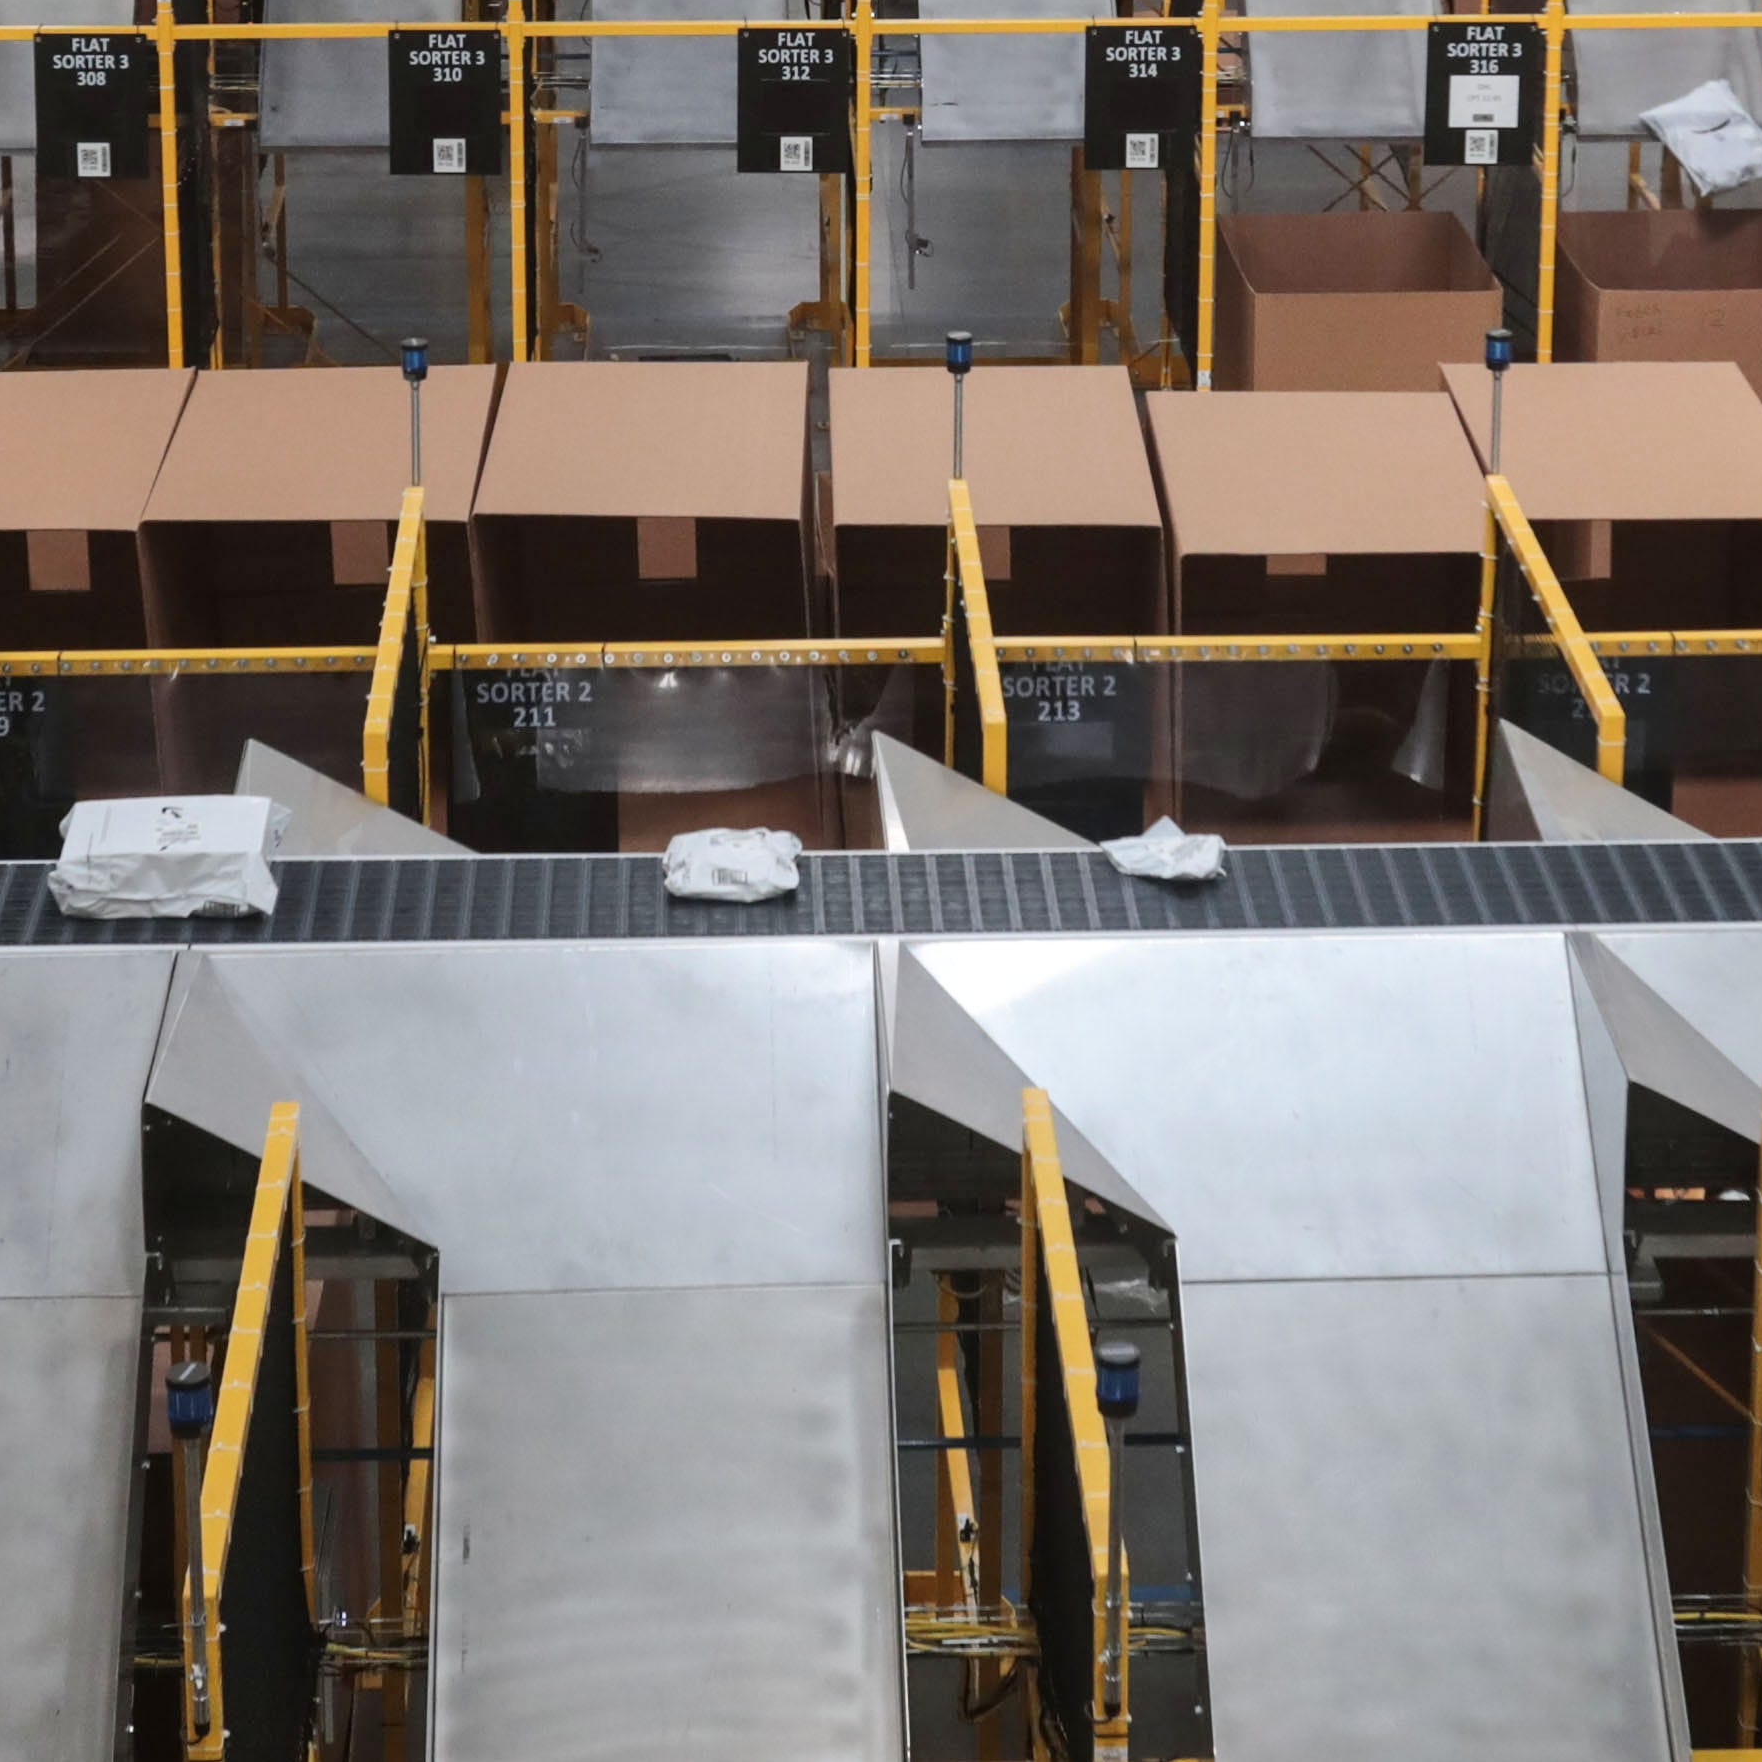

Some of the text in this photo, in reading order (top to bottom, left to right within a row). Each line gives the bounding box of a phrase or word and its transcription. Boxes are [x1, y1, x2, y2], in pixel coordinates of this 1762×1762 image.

[428, 33, 467, 49] FLAT
[777, 32, 816, 48] FLAT
[1125, 30, 1163, 46] FLAT
[1466, 26, 1505, 40] FLAT
[71, 37, 110, 53] FLAT
[1447, 43, 1523, 57] SORTER 3
[52, 54, 130, 70] SORTER 3
[408, 49, 486, 66] SORTER 3
[758, 48, 835, 65] SORTER 3
[1105, 46, 1181, 62] SORTER 3
[432, 66, 463, 83] 310
[781, 65, 811, 81] 312
[1128, 63, 1158, 79] 314
[1470, 60, 1500, 74] 316
[76, 70, 107, 86] 308
[1003, 674, 1117, 698] SORTER 2
[1636, 672, 1651, 694] 2
[476, 680, 593, 704] SORTER 2
[29, 691, 46, 712] 2
[513, 706, 557, 728] 211
[1038, 700, 1082, 722] 213
